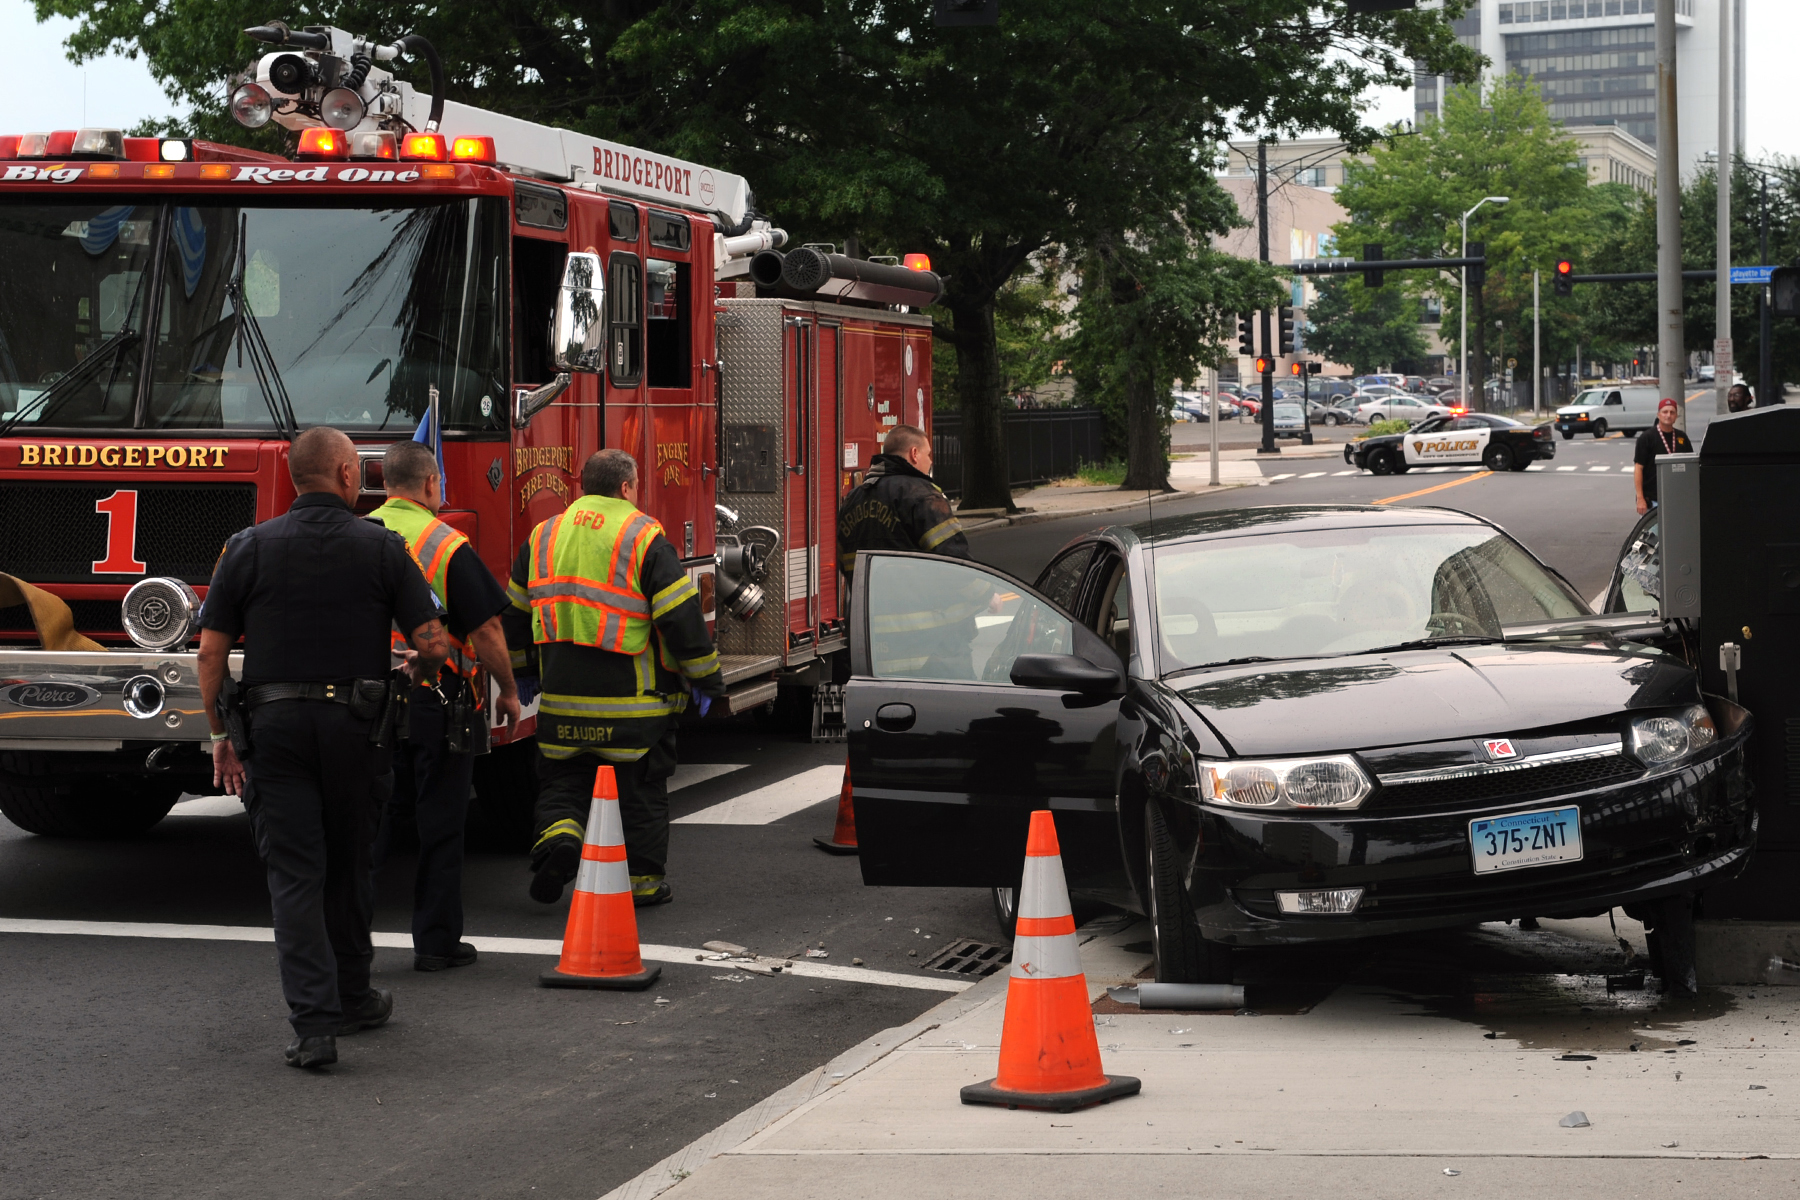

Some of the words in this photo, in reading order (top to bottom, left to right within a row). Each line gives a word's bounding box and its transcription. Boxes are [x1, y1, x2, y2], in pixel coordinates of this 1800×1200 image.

[0, 162, 85, 184] Big
[231, 166, 330, 184] Red
[337, 165, 420, 183] One
[592, 145, 691, 197] BRIDGEPORT
[483, 400, 491, 411] 26
[19, 444, 229, 468] BRIDGEPORT
[656, 442, 689, 468] ENGINE
[1424, 440, 1479, 452] POLICE
[515, 445, 573, 478] BRIDGEPORT
[663, 465, 681, 486] ONE
[520, 473, 543, 513] FIRE
[573, 509, 605, 530] BFD
[840, 499, 901, 537] BRIDGEPORT
[92, 489, 146, 574] 1
[18, 685, 77, 704] Pierce
[557, 725, 613, 741] BEAUDRY
[1500, 815, 1549, 828] Connecticut
[1501, 855, 1540, 866] Constitution
